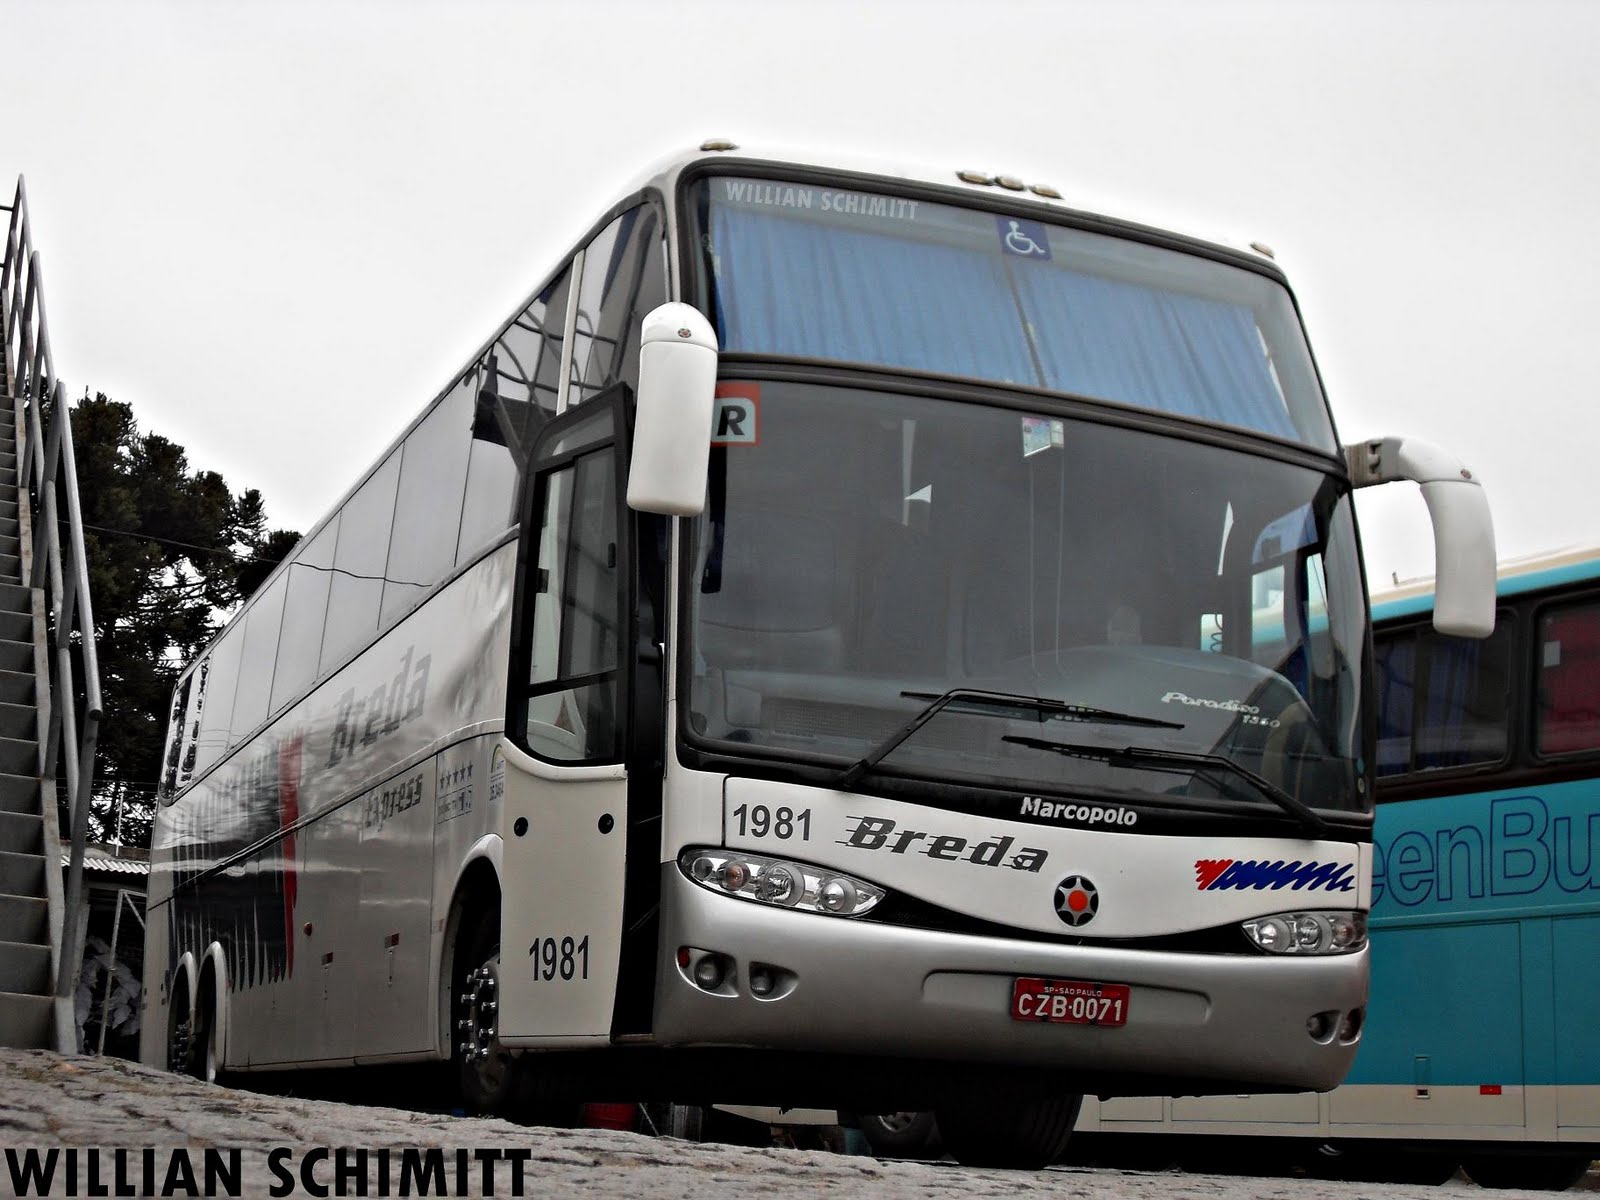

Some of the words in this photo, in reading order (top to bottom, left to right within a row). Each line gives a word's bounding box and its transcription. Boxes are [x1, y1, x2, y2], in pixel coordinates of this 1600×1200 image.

[732, 803, 812, 842] 1981
[1019, 796, 1138, 826] Marcopolo
[834, 815, 1050, 874] Breda
[529, 934, 589, 982] 1981
[1076, 988, 1103, 998] PAULO
